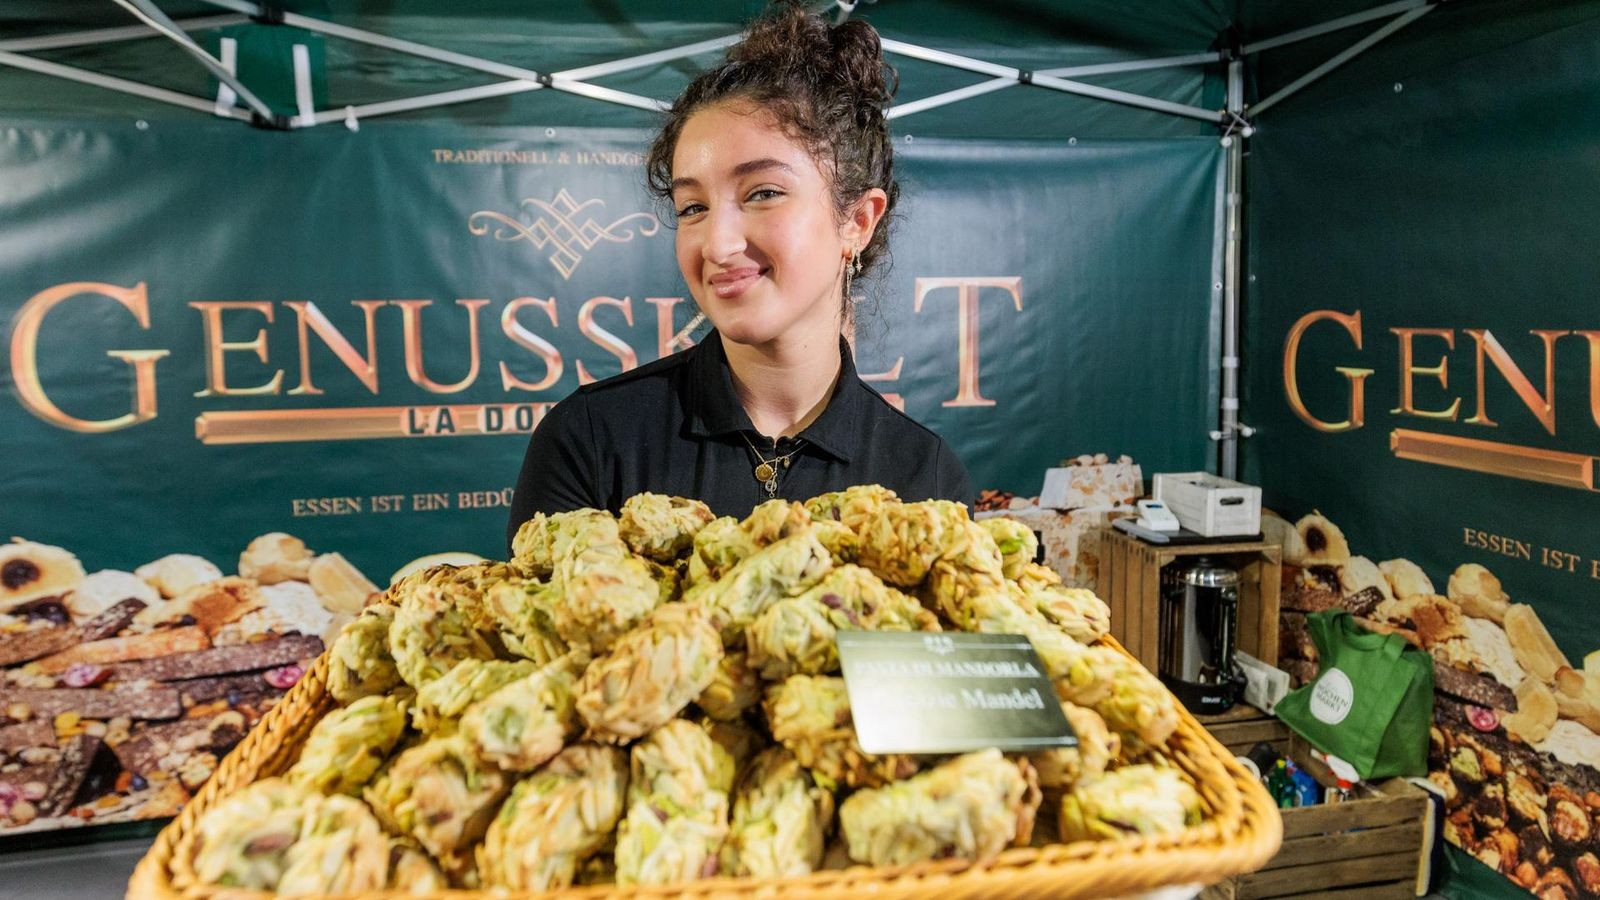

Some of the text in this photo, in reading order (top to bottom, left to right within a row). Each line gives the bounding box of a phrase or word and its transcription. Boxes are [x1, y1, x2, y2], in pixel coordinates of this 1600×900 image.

[432, 149, 649, 166] TRADITIONELL & HANDGE
[10, 276, 1023, 434] GENUSSKLT
[408, 403, 552, 434] LA DO
[292, 487, 514, 517] ESSEN IST EIN BEDÜ
[1463, 527, 1531, 560] ESSEN
[1541, 547, 1581, 573] IST
[961, 688, 1046, 709] Mandel
